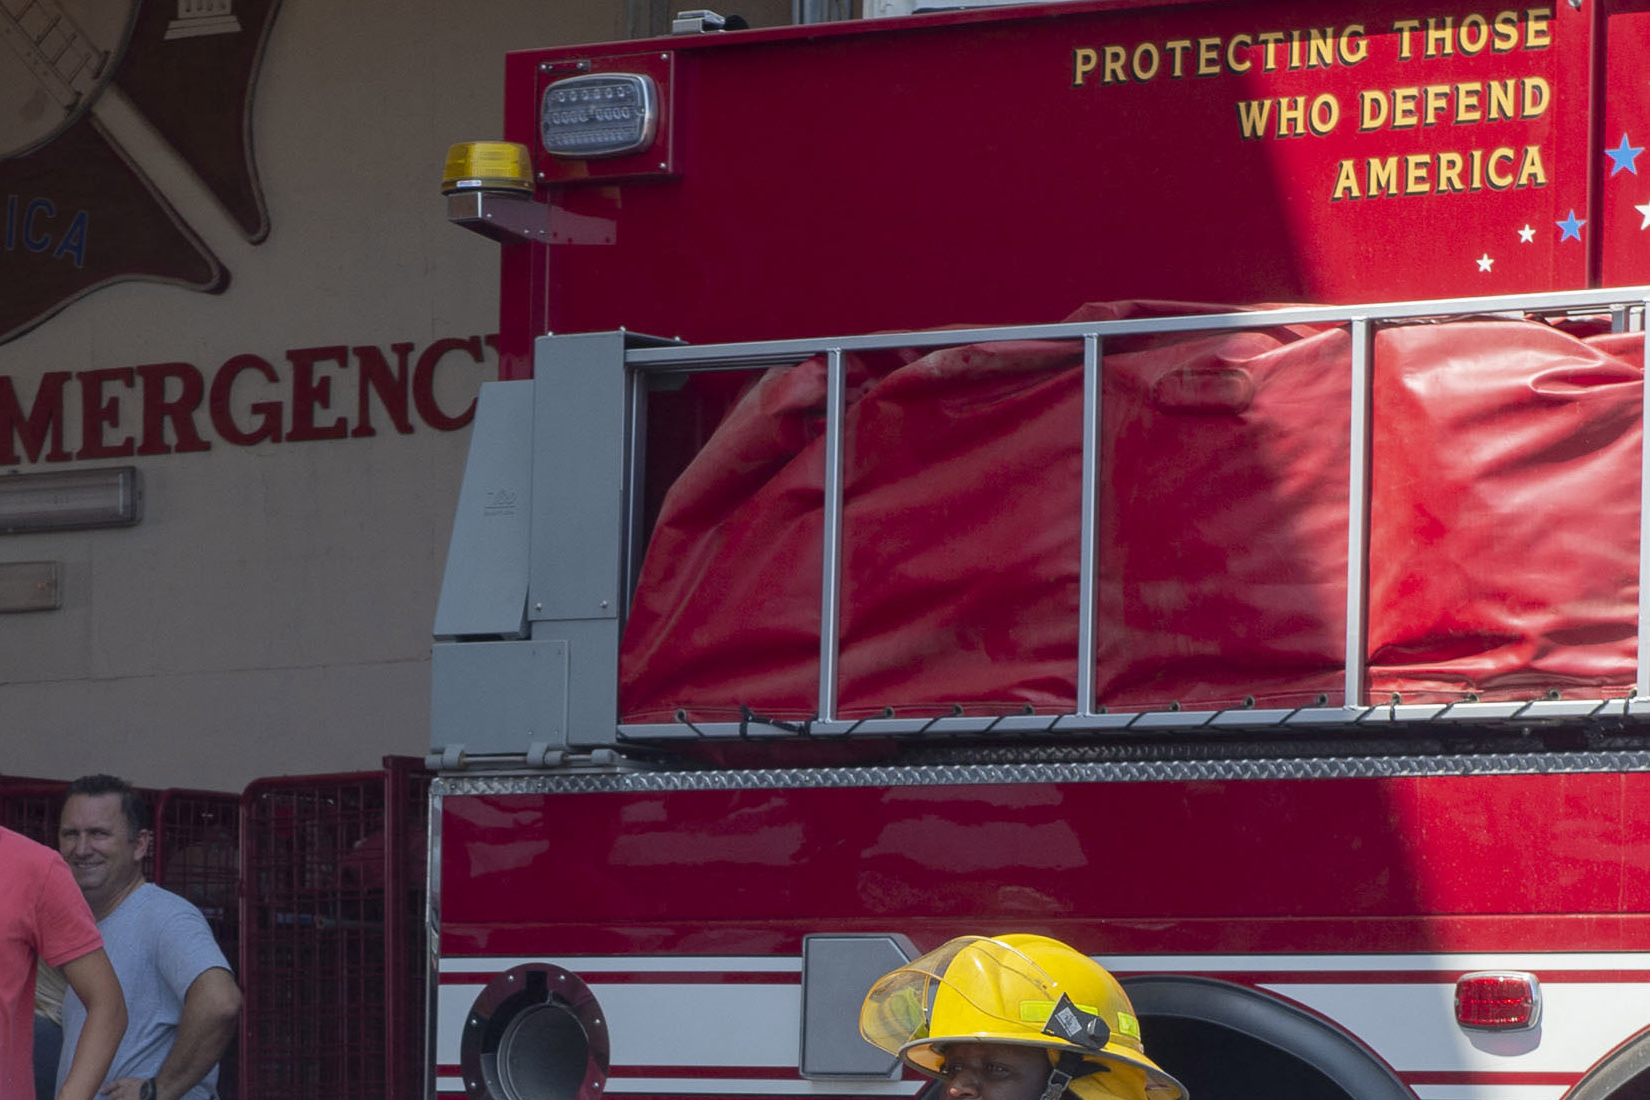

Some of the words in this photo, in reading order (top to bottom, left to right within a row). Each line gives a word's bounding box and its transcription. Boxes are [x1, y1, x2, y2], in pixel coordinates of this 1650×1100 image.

[1073, 24, 1368, 86] PROTECTING
[1392, 7, 1552, 59] THOSE
[1237, 93, 1340, 138] WHO
[1360, 78, 1551, 131] DEFEND
[1332, 145, 1547, 200] AMERICA
